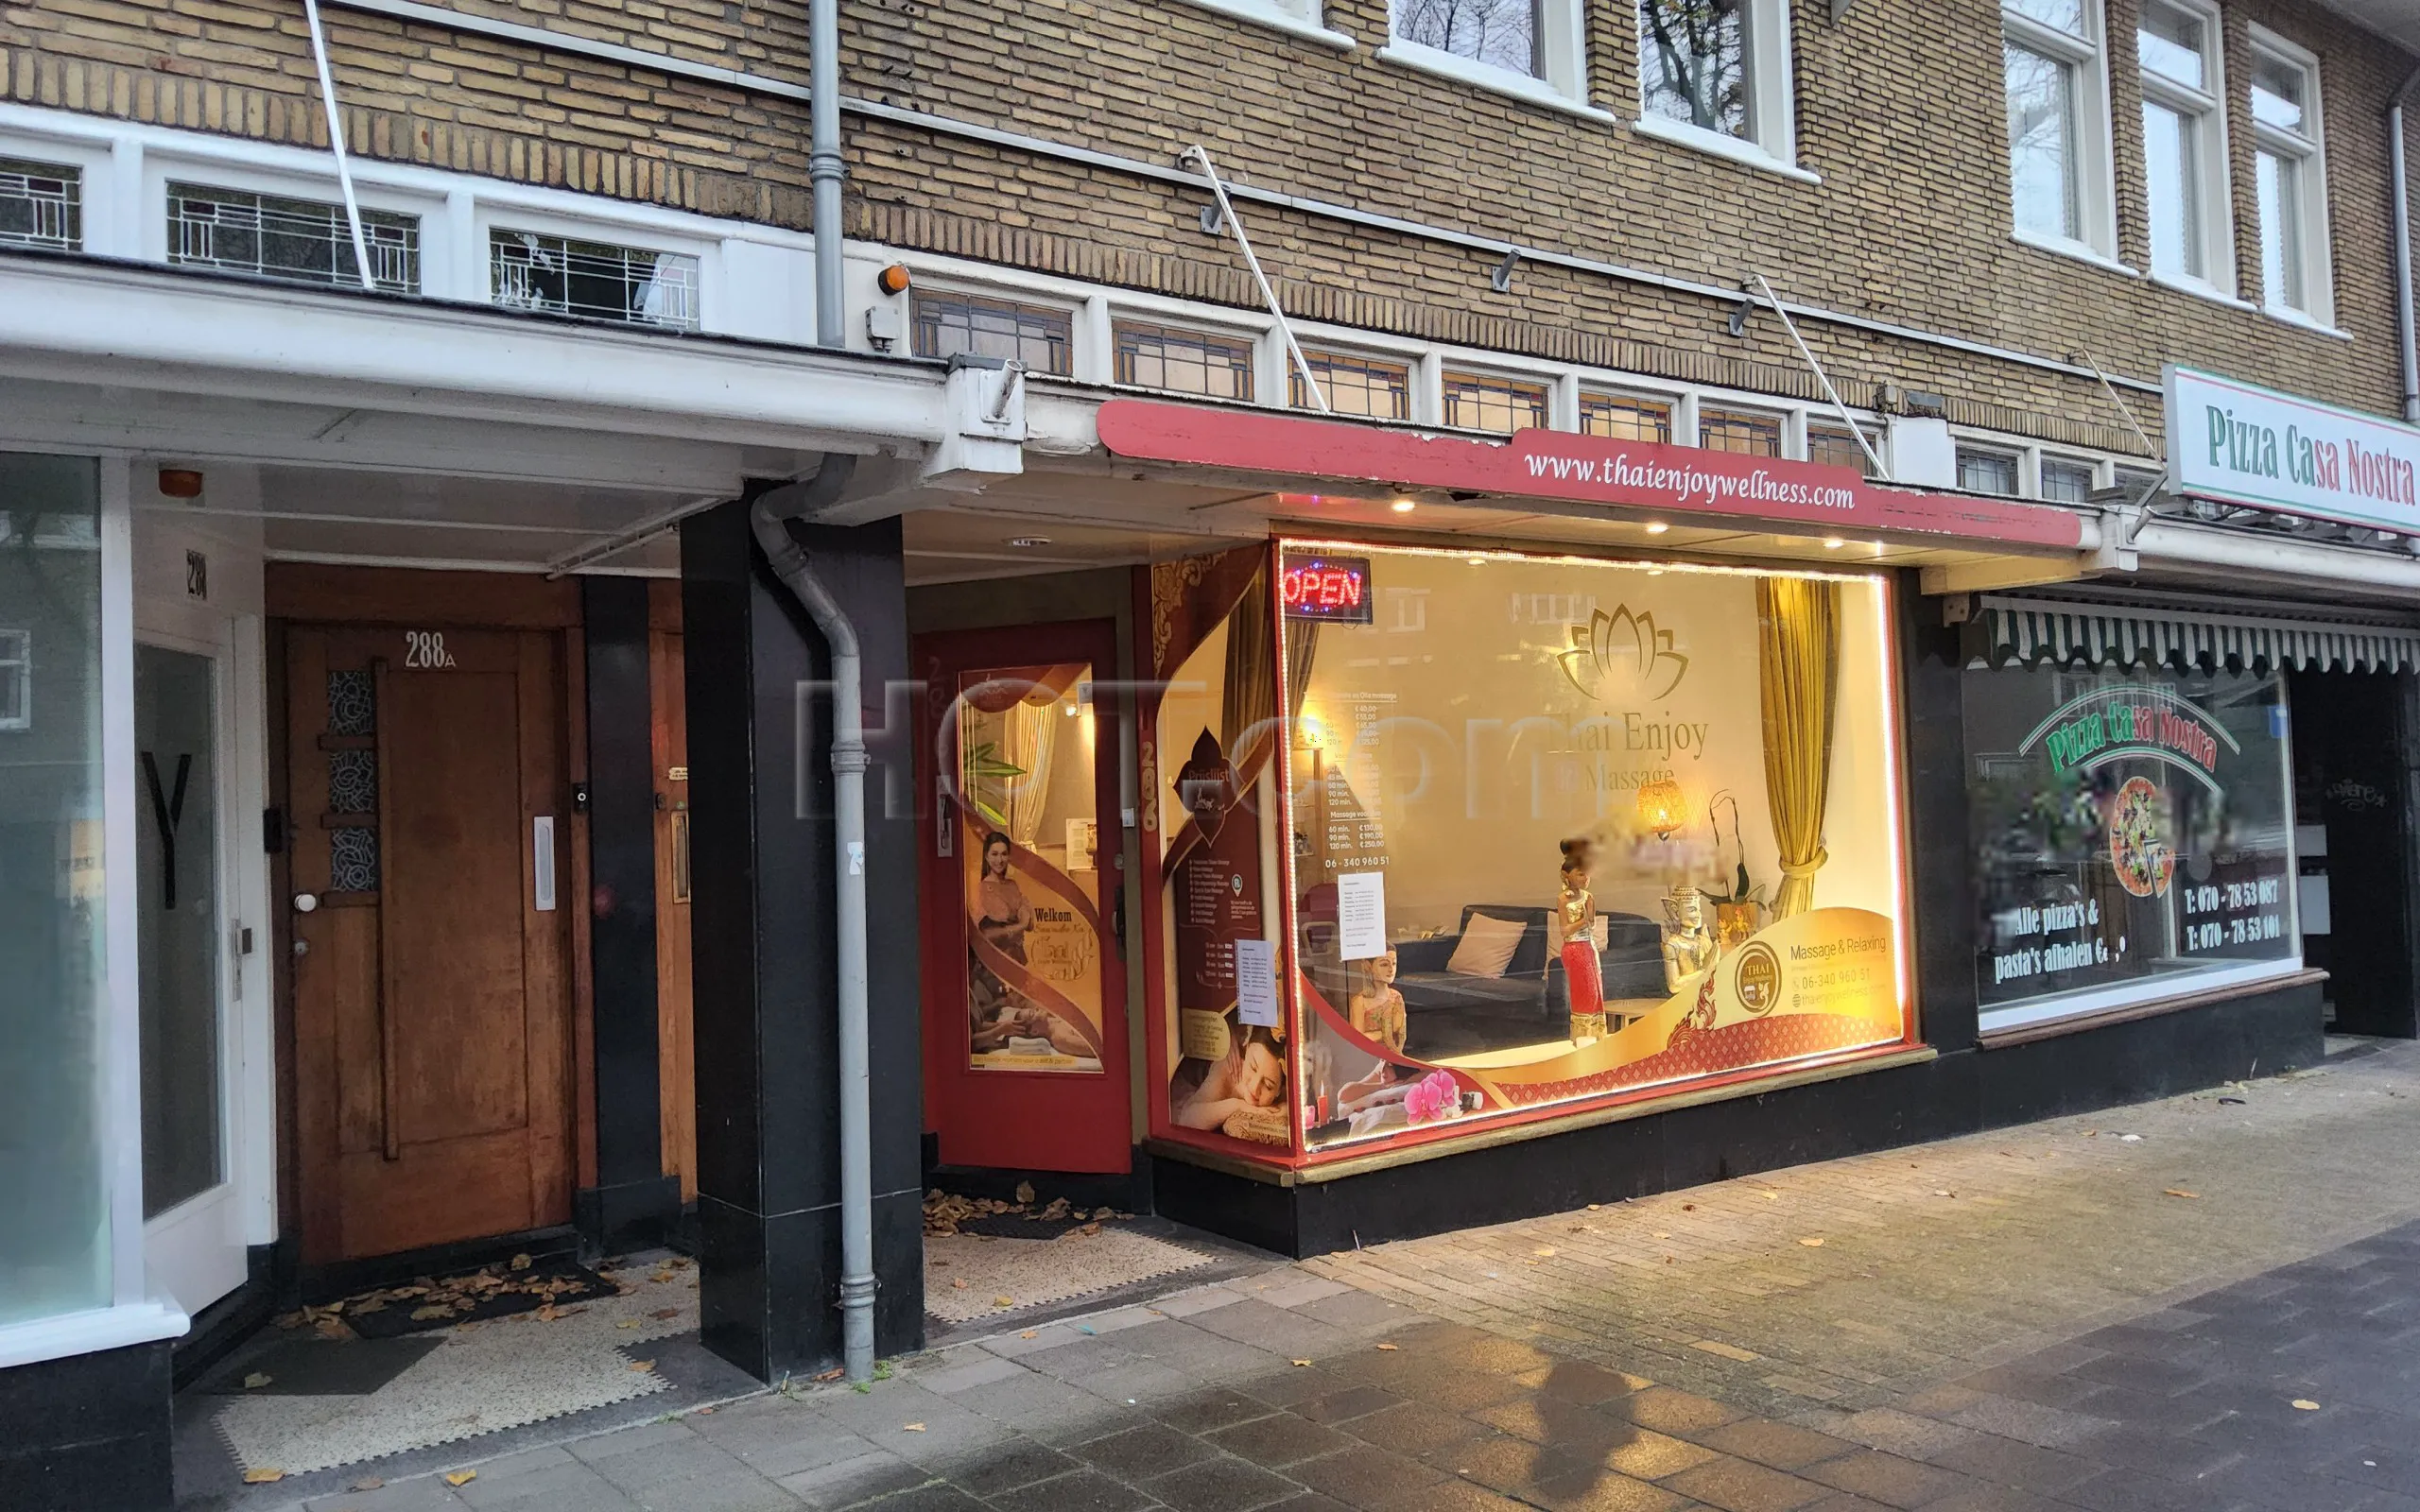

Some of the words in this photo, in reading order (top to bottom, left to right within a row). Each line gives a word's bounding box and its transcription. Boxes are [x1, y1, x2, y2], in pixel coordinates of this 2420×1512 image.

[2205, 404, 2279, 480] Pizza
[2286, 424, 2341, 491] Casa
[2346, 438, 2415, 507] Nostra
[1525, 453, 1855, 509] www.thaienjoywellness.com
[1284, 572, 1361, 606] OPEN
[1622, 711, 1709, 762] Enjoy
[2046, 712, 2106, 773] Pizza
[2107, 700, 2154, 743] Casa
[2158, 704, 2218, 773] Nostra
[1141, 741, 1158, 833] 286
[1585, 765, 1675, 796] Massage
[1325, 859, 1337, 868] 06
[1343, 858, 1360, 868] 340
[1362, 856, 1379, 866] 960
[1380, 856, 1390, 865] 51
[1034, 908, 1072, 922] Welkom
[2185, 888, 2196, 915] T:
[2198, 885, 2220, 913] 070
[2227, 884, 2242, 908] 78
[2243, 882, 2257, 907] 53
[2258, 879, 2278, 904] 087
[2042, 900, 2085, 936] pizza's
[2087, 898, 2099, 925] &
[2187, 925, 2199, 952] T:
[2200, 922, 2222, 949] 070
[2231, 919, 2246, 944] 78
[2247, 916, 2262, 941] 53
[2263, 914, 2280, 939] 101
[1790, 944, 1837, 961] Massage
[1838, 939, 1845, 954] &
[1846, 935, 1886, 954] Relaxing
[1994, 947, 2042, 985] pasta's
[2044, 941, 2093, 972] afhalen
[1746, 963, 1770, 976] THAI
[1802, 972, 1836, 989] 06-340
[1839, 970, 1857, 984] 960
